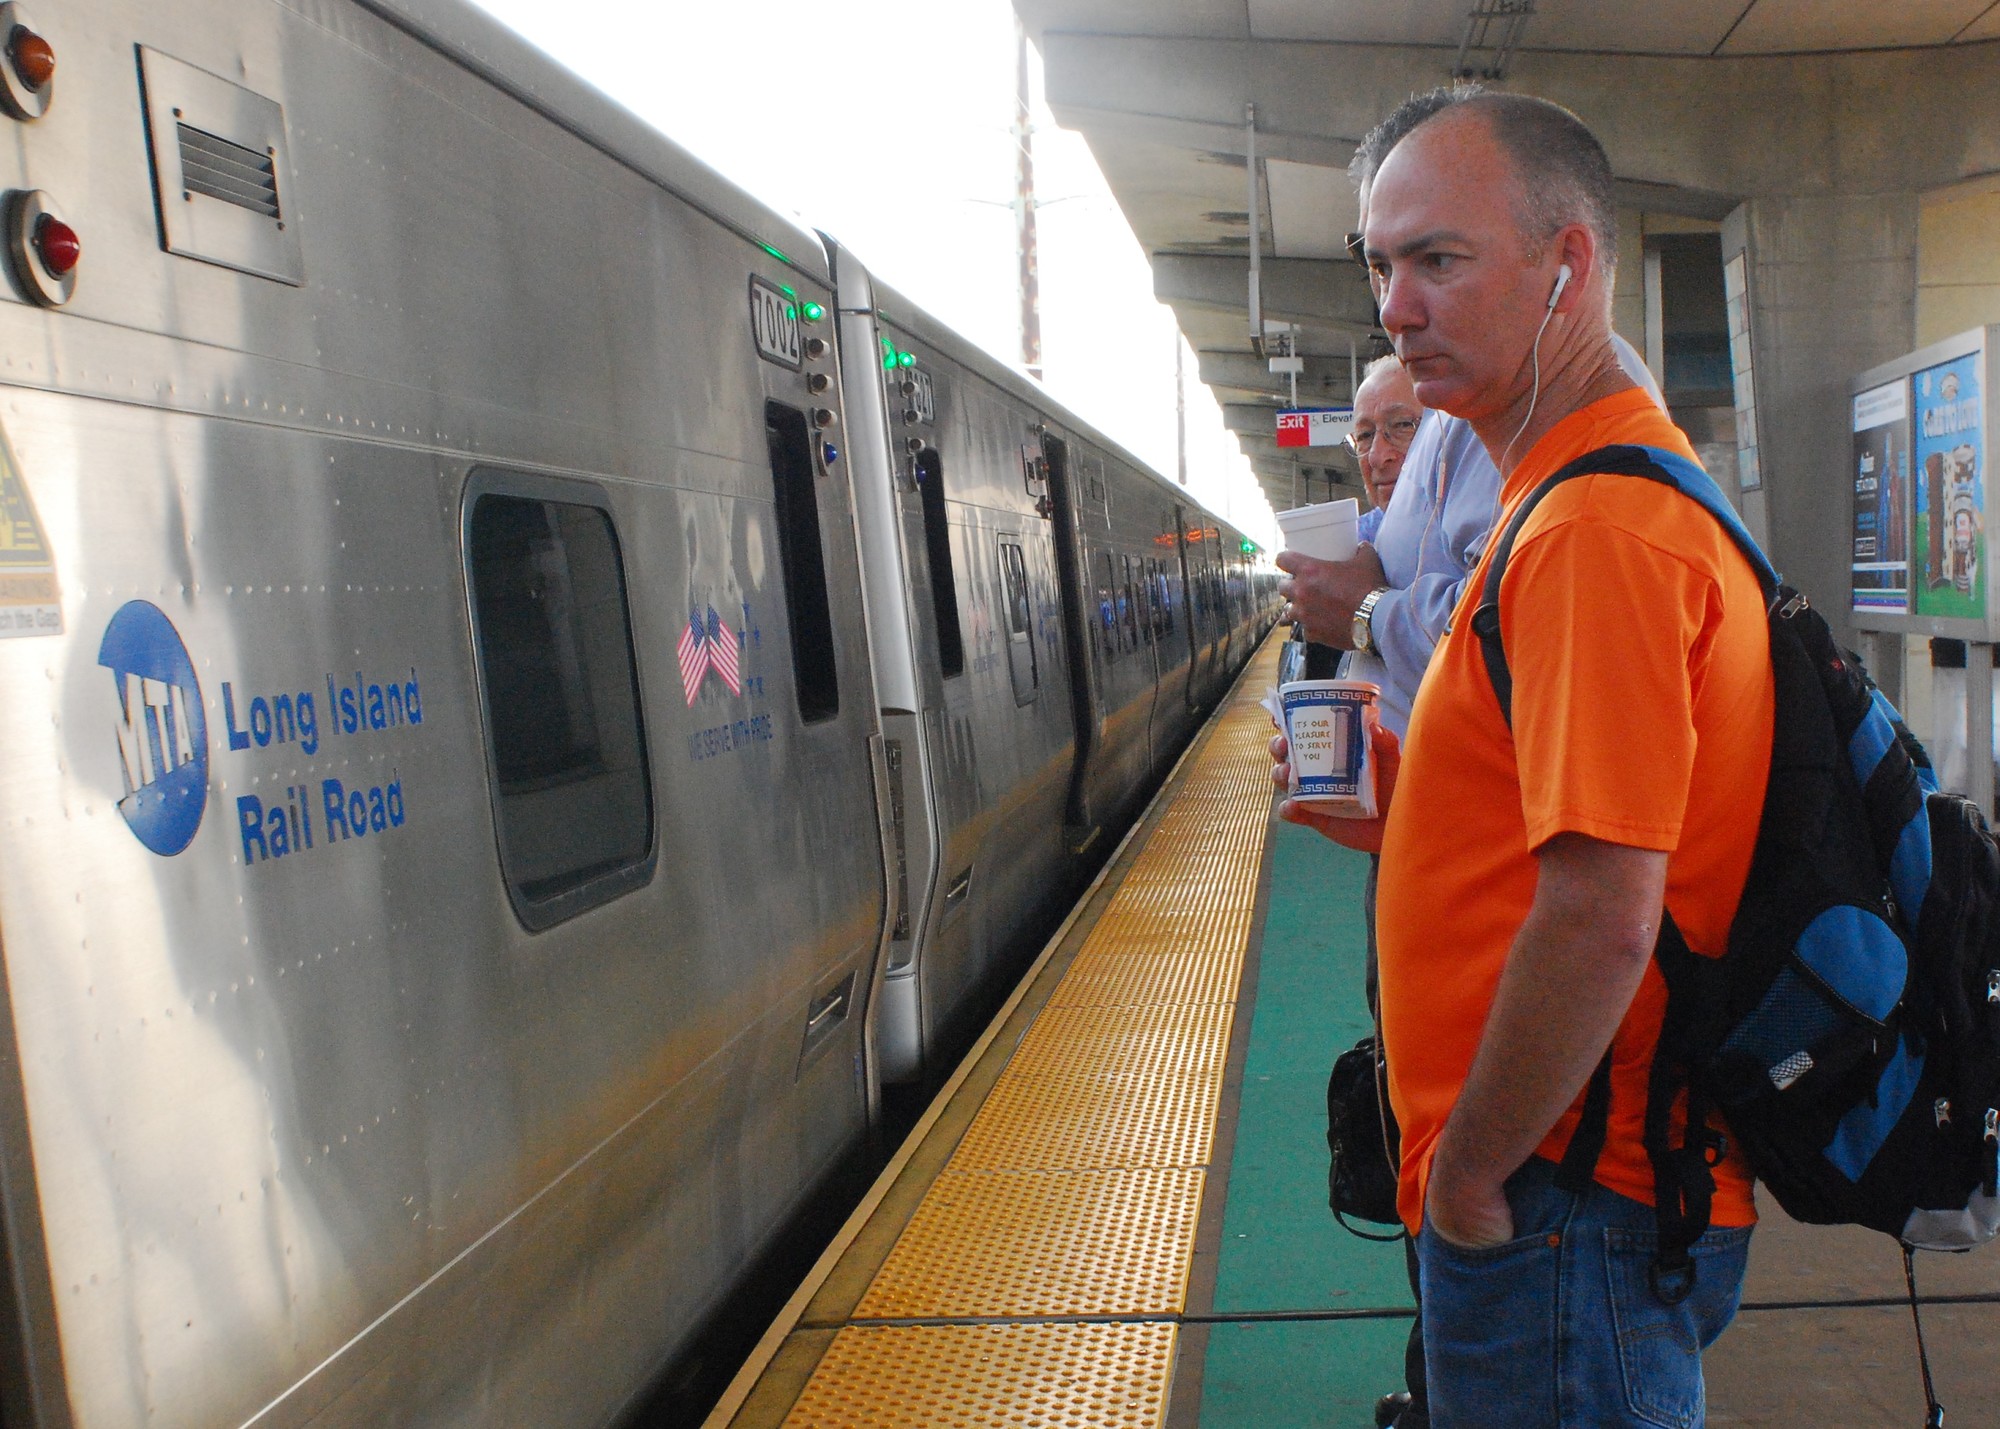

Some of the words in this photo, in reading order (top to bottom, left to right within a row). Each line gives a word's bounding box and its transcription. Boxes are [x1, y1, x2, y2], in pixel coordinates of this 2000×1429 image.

[753, 289, 798, 357] 7002
[1276, 414, 1304, 429] Exit
[222, 681, 319, 755] Long
[327, 667, 424, 736] Island
[103, 666, 194, 796] MTA
[1311, 720, 1329, 728] OUR
[1295, 731, 1331, 739] PLEASURE
[1307, 742, 1332, 750] SERVE
[1303, 753, 1320, 761] YOU
[236, 785, 314, 865] Rail
[322, 768, 405, 843] Road
